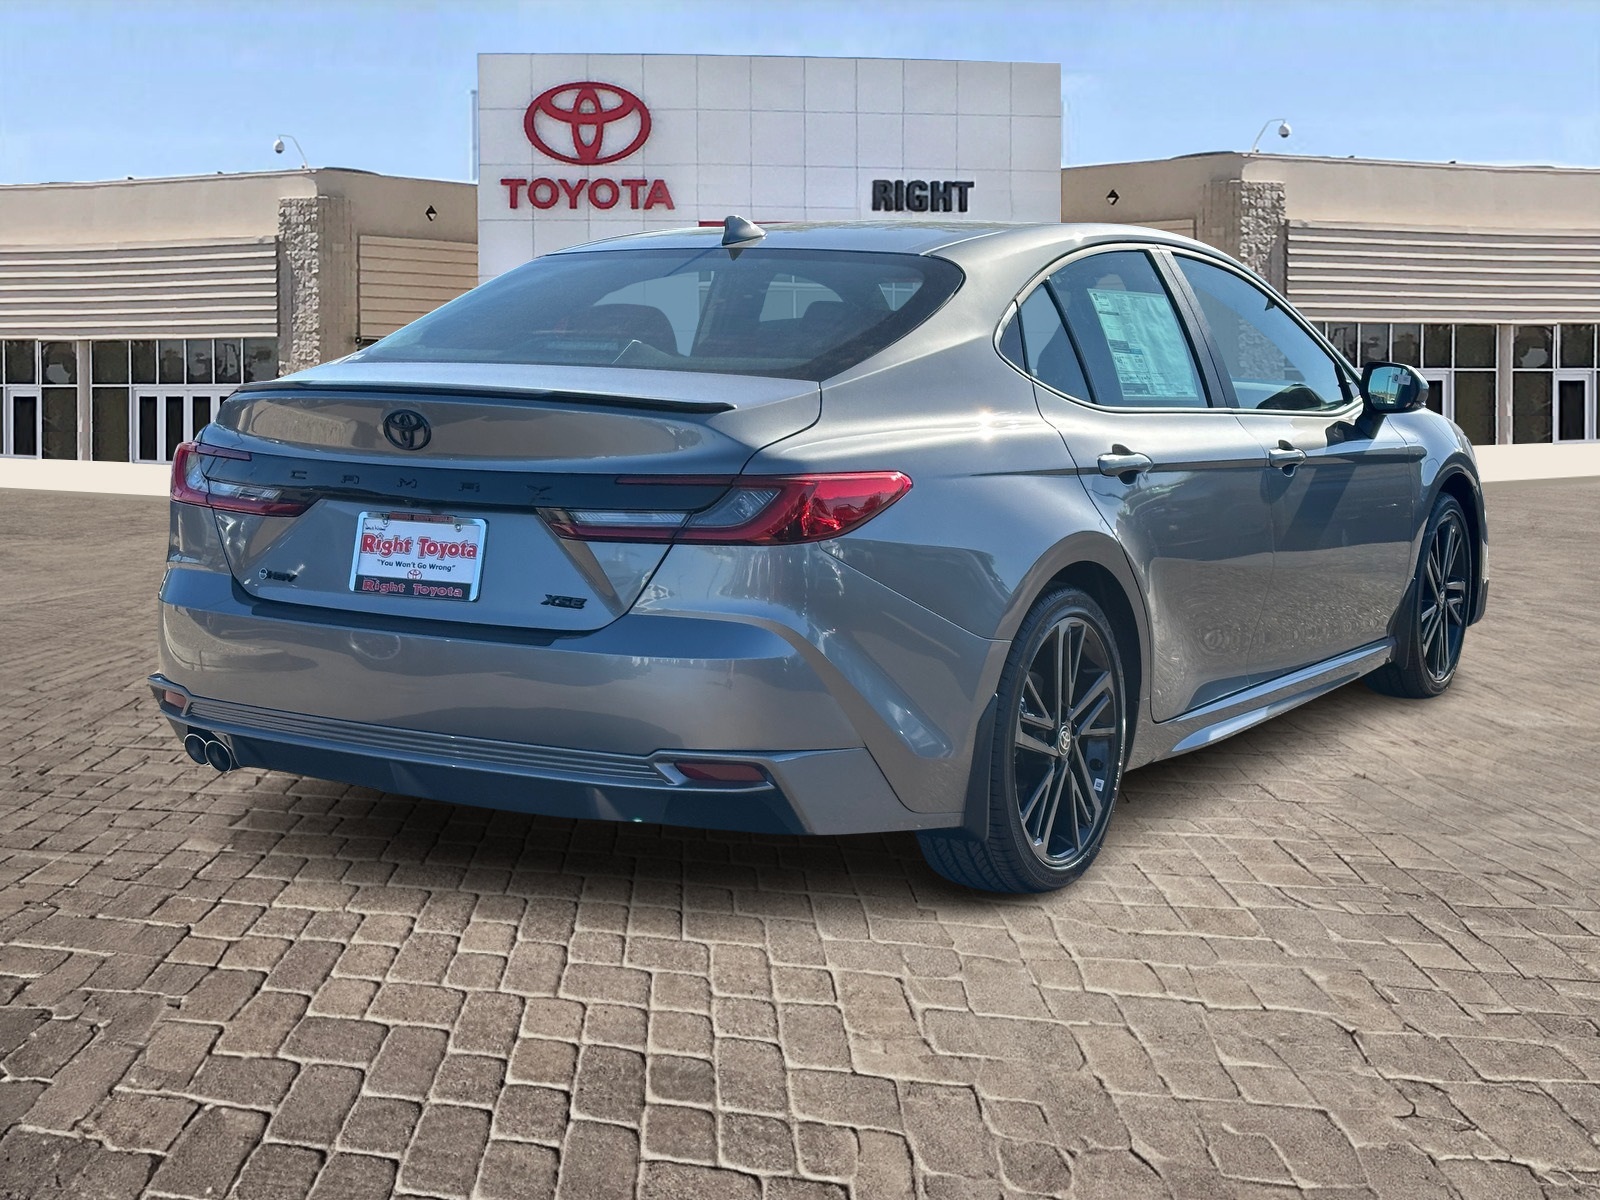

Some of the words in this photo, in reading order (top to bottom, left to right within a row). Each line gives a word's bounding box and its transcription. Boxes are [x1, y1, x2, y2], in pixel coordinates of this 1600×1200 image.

[500, 178, 675, 210] TOYOTA
[872, 180, 974, 212] RIGHT
[290, 470, 551, 497] CAMRY
[361, 532, 413, 558] Right
[417, 536, 478, 561] Toyota
[396, 561, 416, 569] Won't
[362, 580, 405, 593] Right
[413, 583, 463, 597] Toyota
